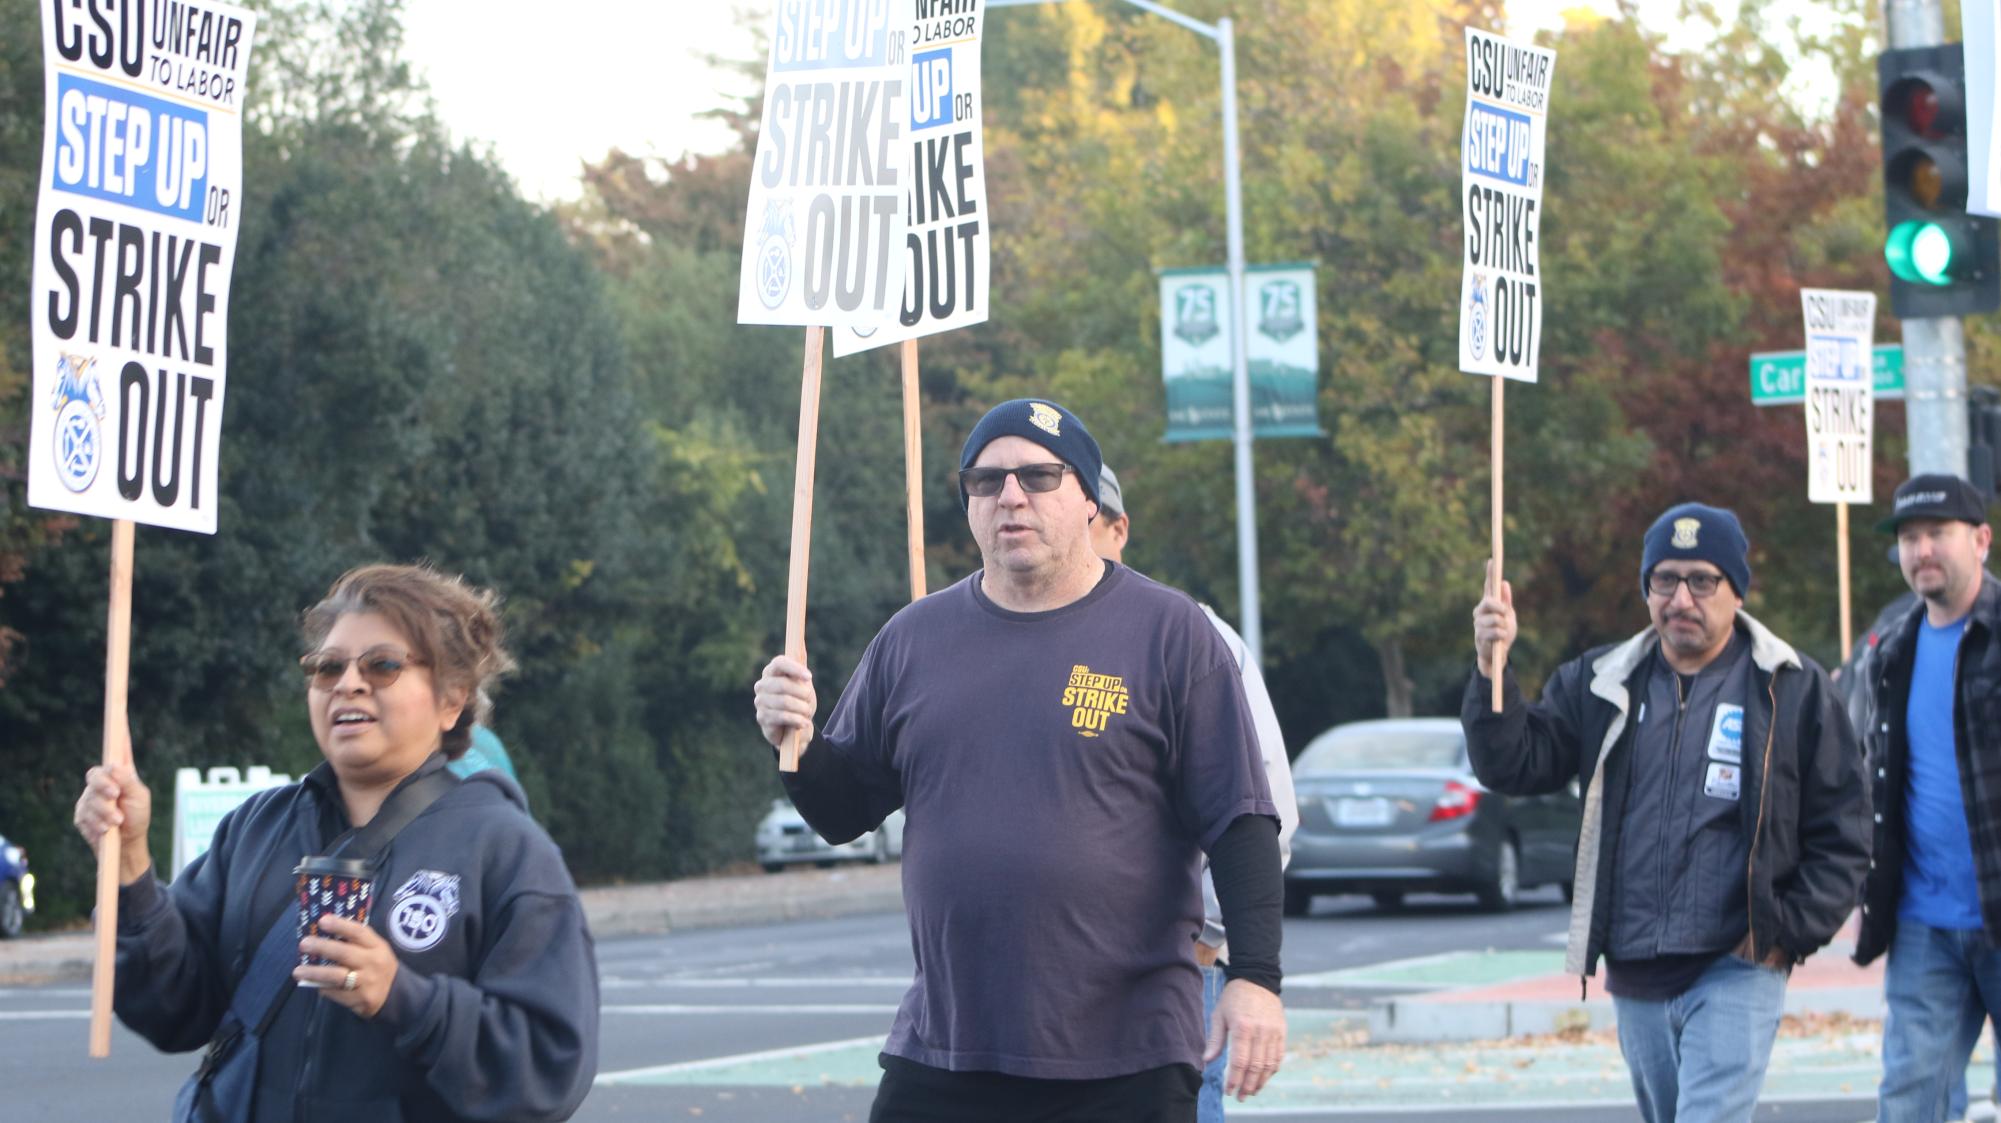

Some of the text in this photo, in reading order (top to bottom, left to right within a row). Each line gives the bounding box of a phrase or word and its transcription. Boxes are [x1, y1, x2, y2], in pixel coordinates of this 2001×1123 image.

[54, 0, 242, 77] CSU UNFAIR
[778, 0, 905, 65] STEP UP OR
[925, 16, 975, 42] LABOR
[151, 55, 235, 104] TO LABOR
[913, 58, 973, 123] UP OR
[1471, 35, 1549, 99] CSU UNFAIR
[1506, 83, 1544, 110] TO LABOR
[58, 89, 229, 228] STEP UP OR
[761, 79, 902, 189] STRIKE
[1470, 108, 1538, 188] STEP UP OR
[908, 131, 977, 226] IKE
[803, 193, 898, 312] OUT
[1469, 184, 1535, 276] STRIKE
[48, 208, 222, 366] STRIKE
[899, 220, 980, 327] OUT
[1495, 275, 1536, 367] OUT
[1760, 362, 1800, 394] Car
[1811, 385, 1866, 435] STRIKE
[117, 361, 214, 510] OUT
[1837, 439, 1866, 492] OUT
[1062, 687, 1129, 715] STRIKE
[1070, 673, 1101, 687] STEP
[1103, 677, 1120, 690] UP
[1071, 707, 1110, 731] OUT
